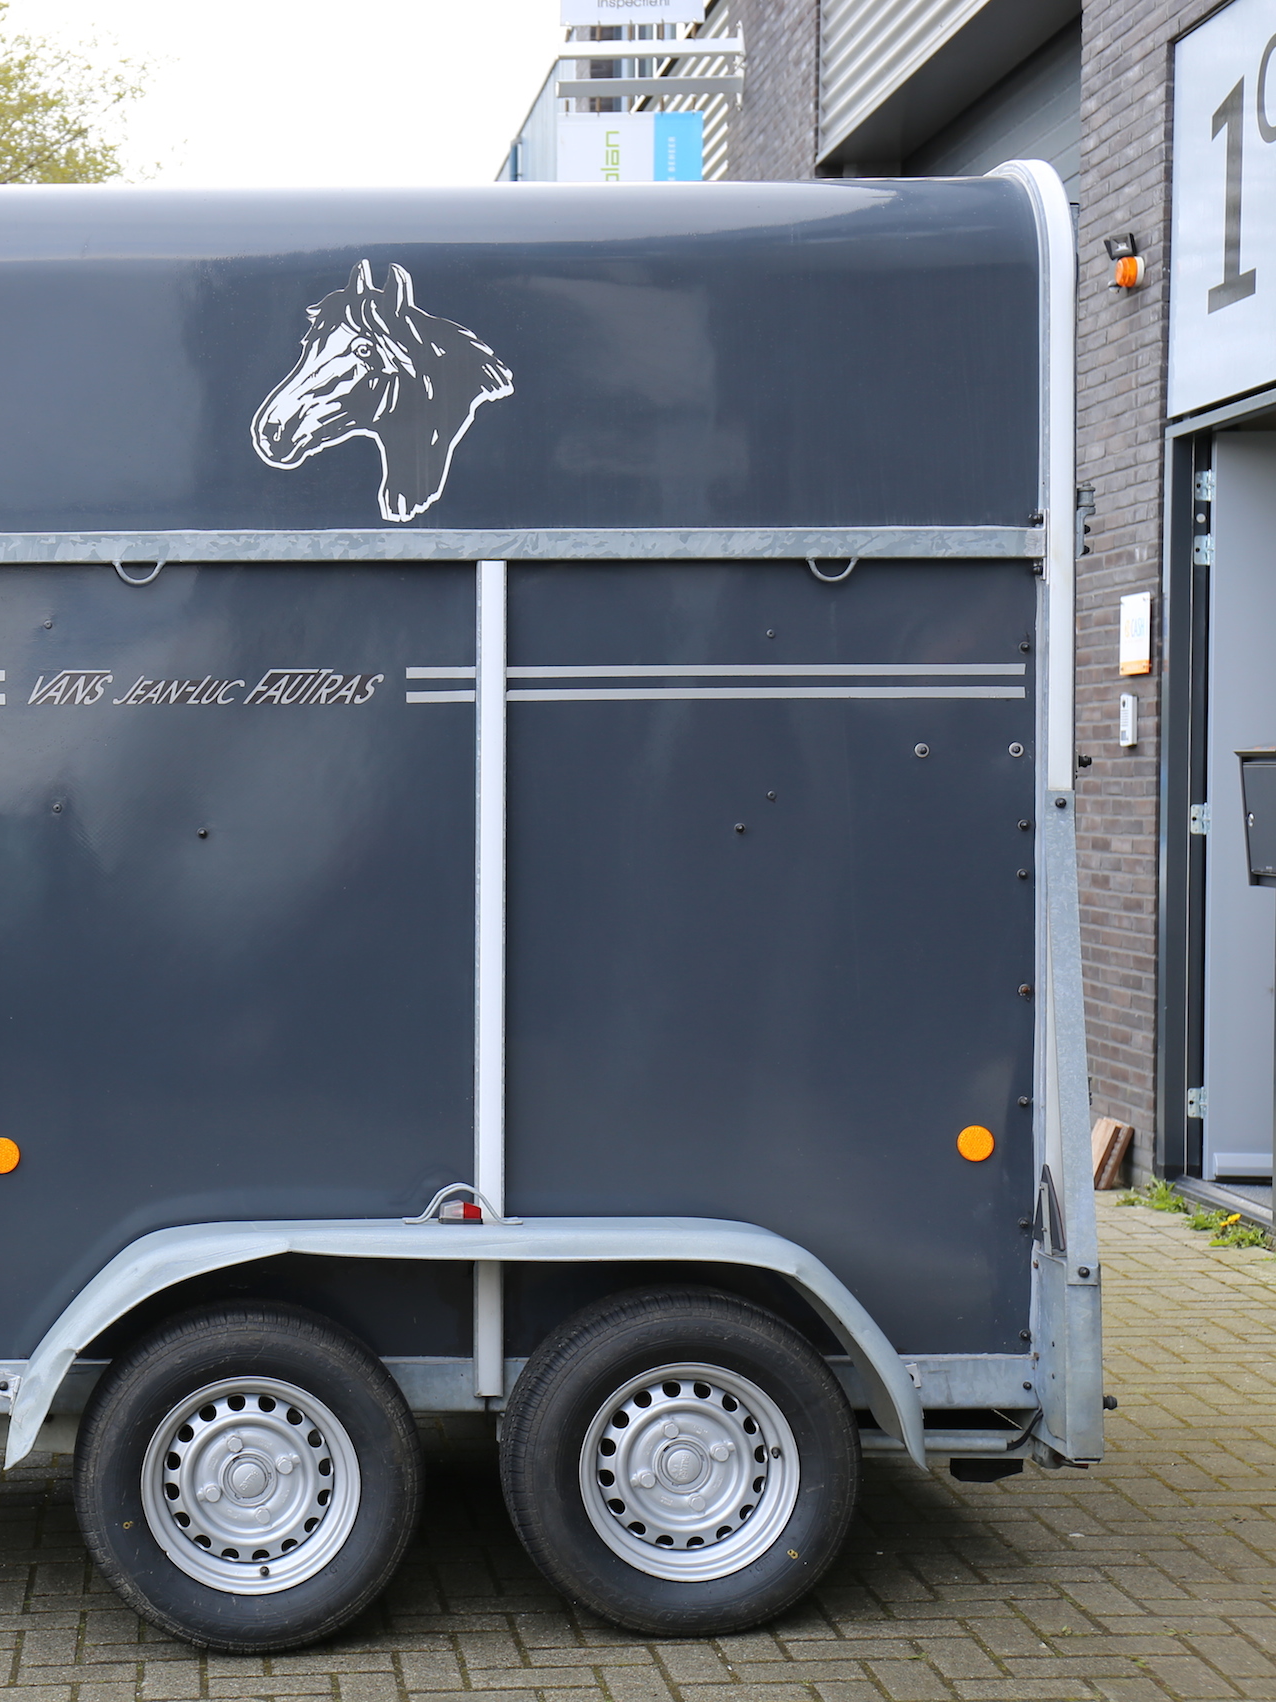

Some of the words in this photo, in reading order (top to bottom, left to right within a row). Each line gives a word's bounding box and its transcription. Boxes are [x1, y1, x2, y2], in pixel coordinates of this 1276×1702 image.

[1207, 32, 1276, 315] 1
[27, 669, 114, 705] VANS
[112, 675, 246, 705] JEAN-LUC
[242, 668, 385, 705] FAUTRAS
